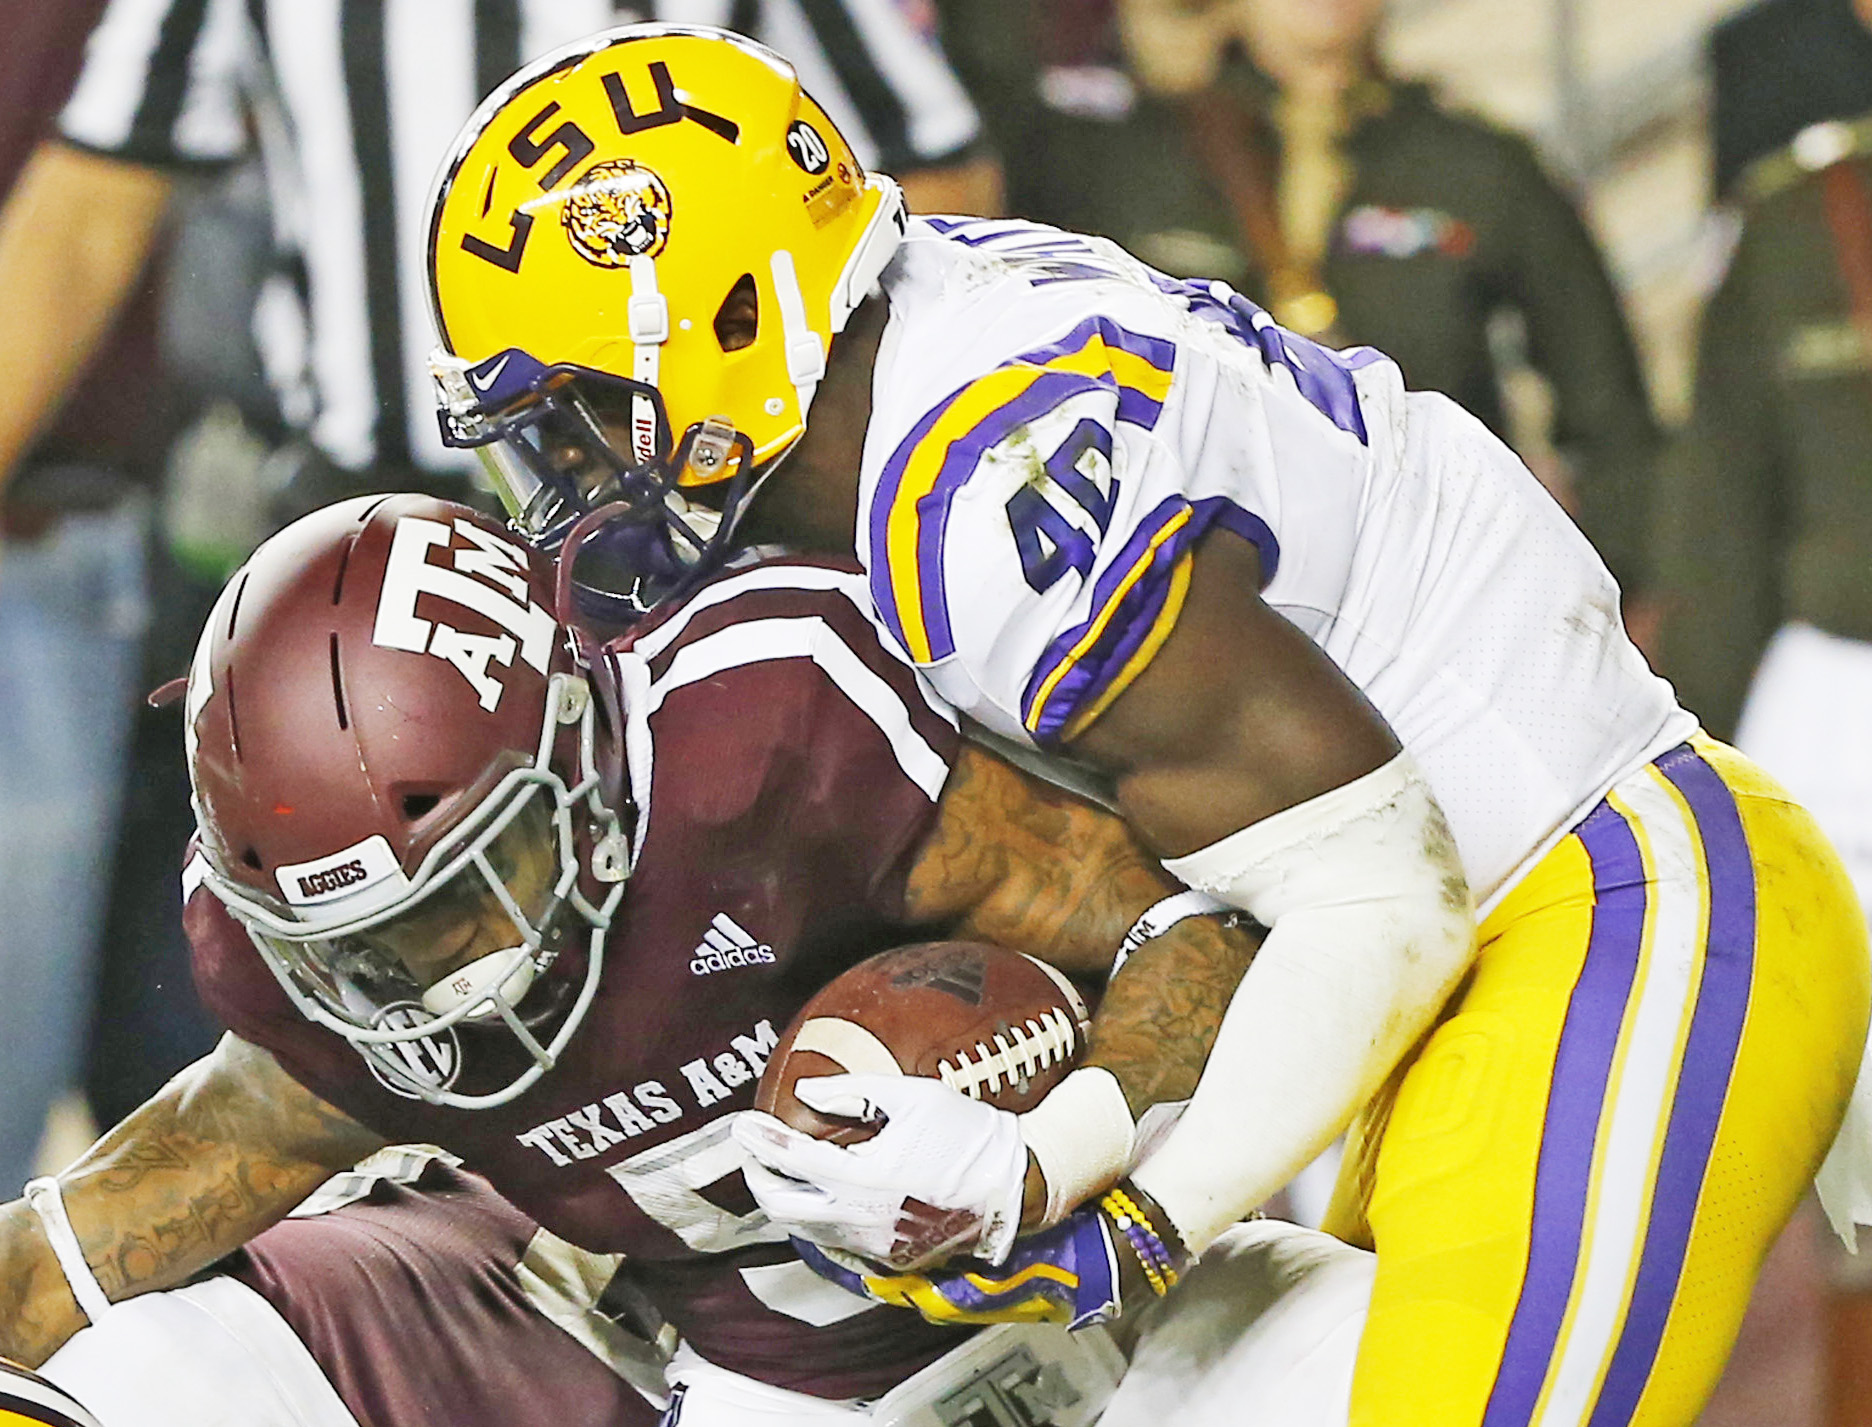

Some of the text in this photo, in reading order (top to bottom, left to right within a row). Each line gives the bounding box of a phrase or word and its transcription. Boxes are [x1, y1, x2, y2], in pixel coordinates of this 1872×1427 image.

[460, 61, 684, 274] LSU
[787, 123, 828, 172] 20
[297, 859, 368, 898] AGGIES
[690, 944, 777, 976] adidas
[515, 1018, 781, 1168] TEXAS A&M
